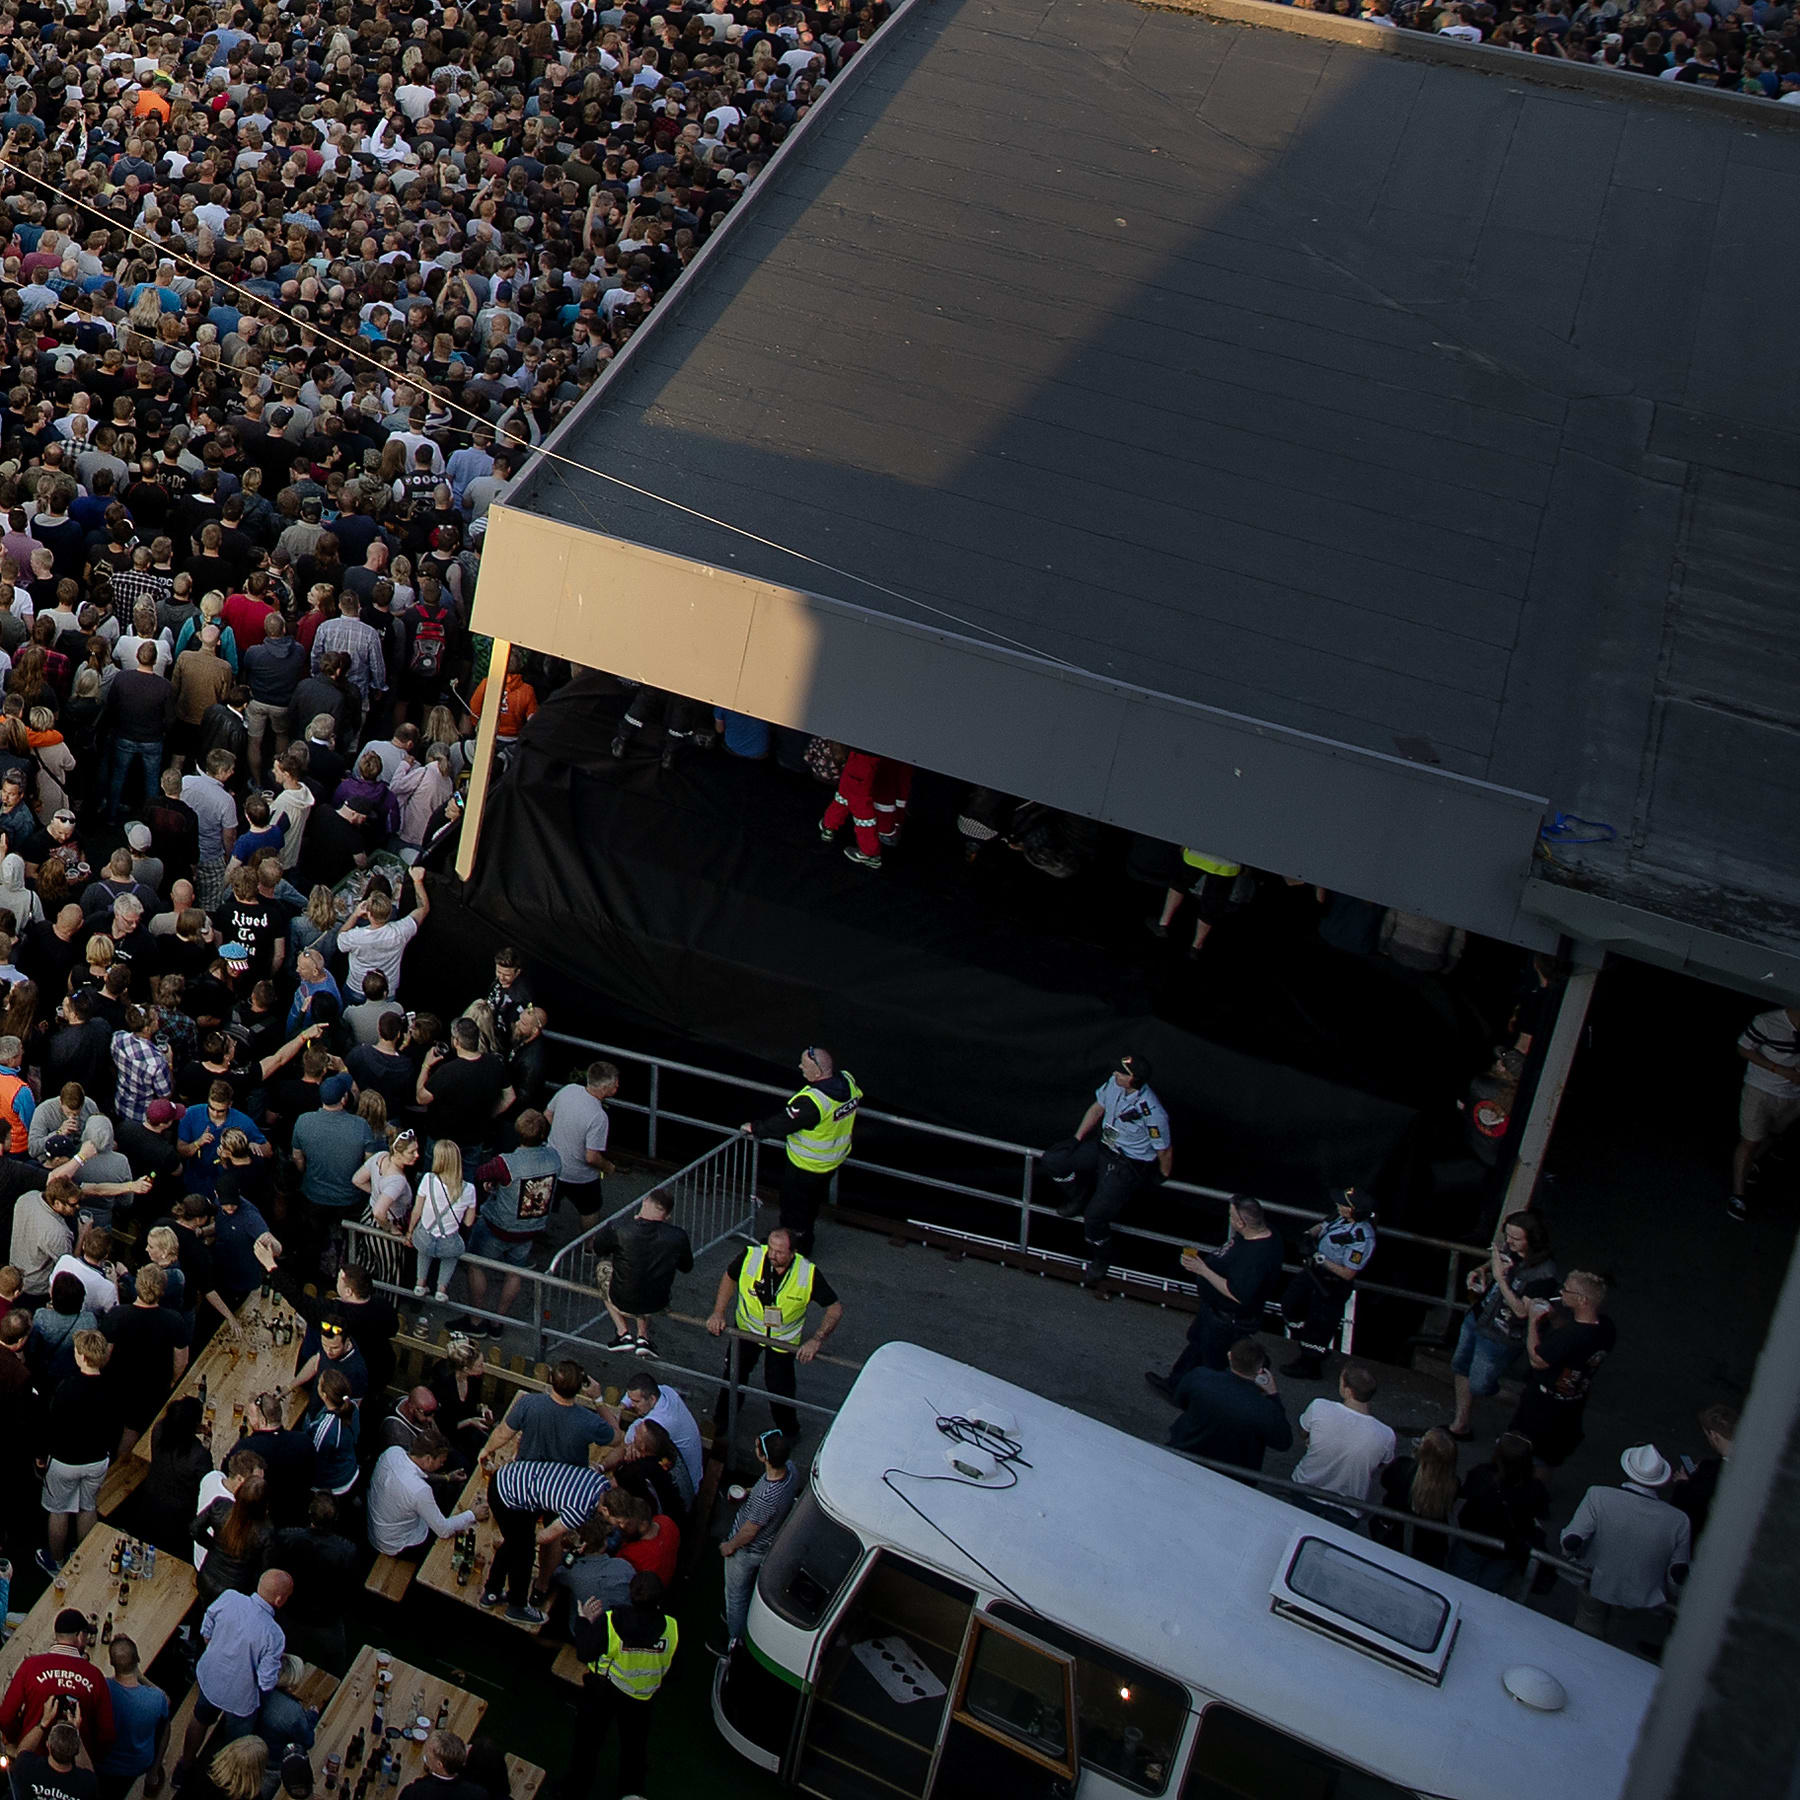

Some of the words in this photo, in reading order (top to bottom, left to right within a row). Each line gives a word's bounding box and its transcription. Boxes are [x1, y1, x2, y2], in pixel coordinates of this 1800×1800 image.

[231, 910, 268, 928] Lived
[36, 1669, 94, 1693] LIVERPOOL
[57, 1677, 75, 1690] F.C.
[31, 1783, 81, 1800] Volbe
